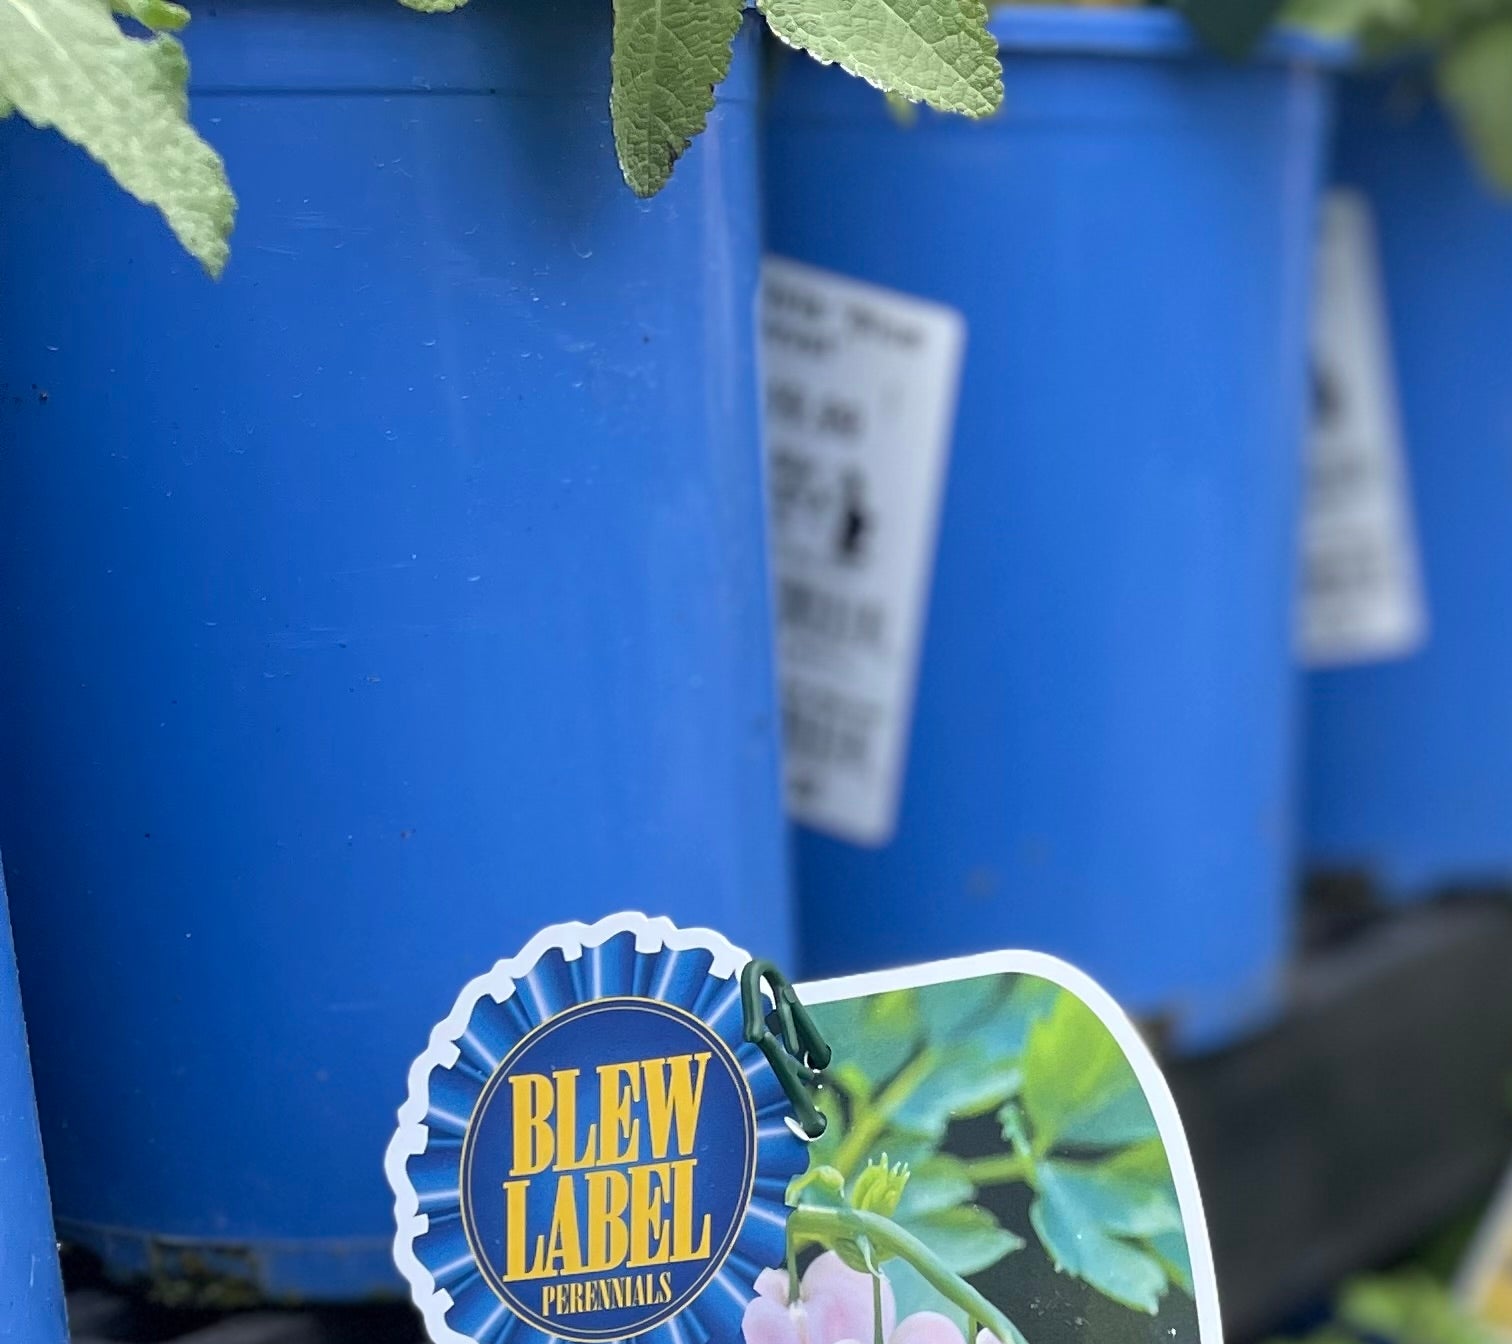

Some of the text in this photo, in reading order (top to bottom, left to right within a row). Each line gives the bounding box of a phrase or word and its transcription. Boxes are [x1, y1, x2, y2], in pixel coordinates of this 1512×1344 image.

[508, 1051, 712, 1176] BLEW
[502, 1158, 712, 1283] LABEL
[541, 1271, 672, 1317] PERENNIALS
